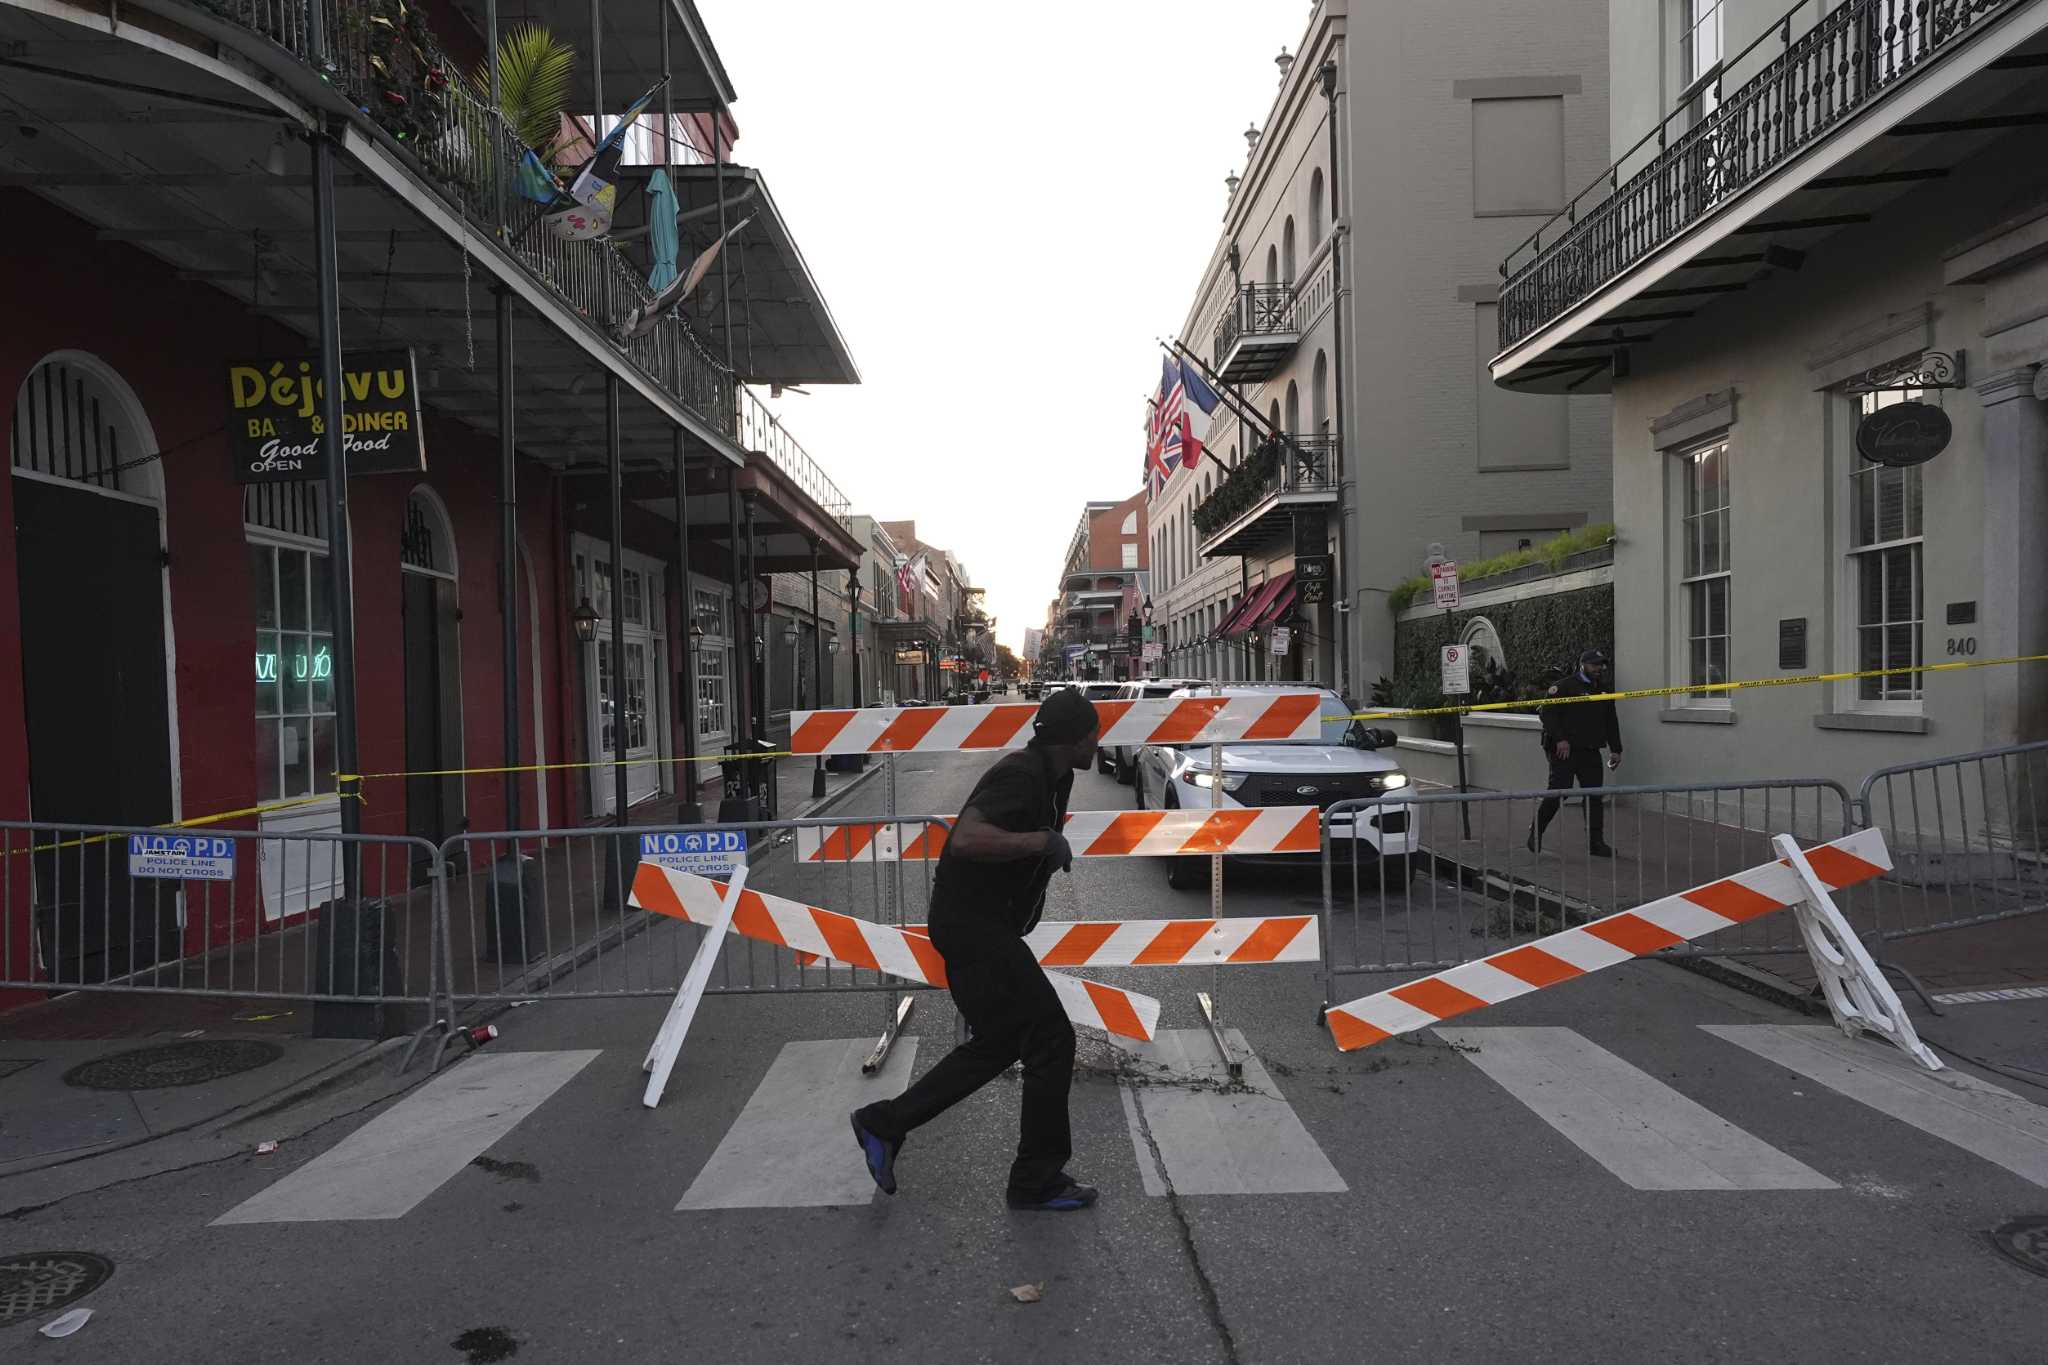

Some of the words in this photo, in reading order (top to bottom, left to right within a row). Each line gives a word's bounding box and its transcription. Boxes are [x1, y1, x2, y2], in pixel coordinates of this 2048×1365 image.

[311, 415, 325, 434] &
[343, 411, 408, 432] DINER
[260, 438, 319, 464] Good
[250, 460, 302, 472] OPEN
[1946, 638, 1977, 656] 840
[706, 832, 744, 851] P.D.
[146, 857, 188, 866] POLICE
[191, 859, 216, 867] LINE
[659, 855, 700, 863] POLICE
[704, 854, 729, 862] LINE
[158, 867, 180, 875] NOT
[184, 868, 224, 876] CROSS
